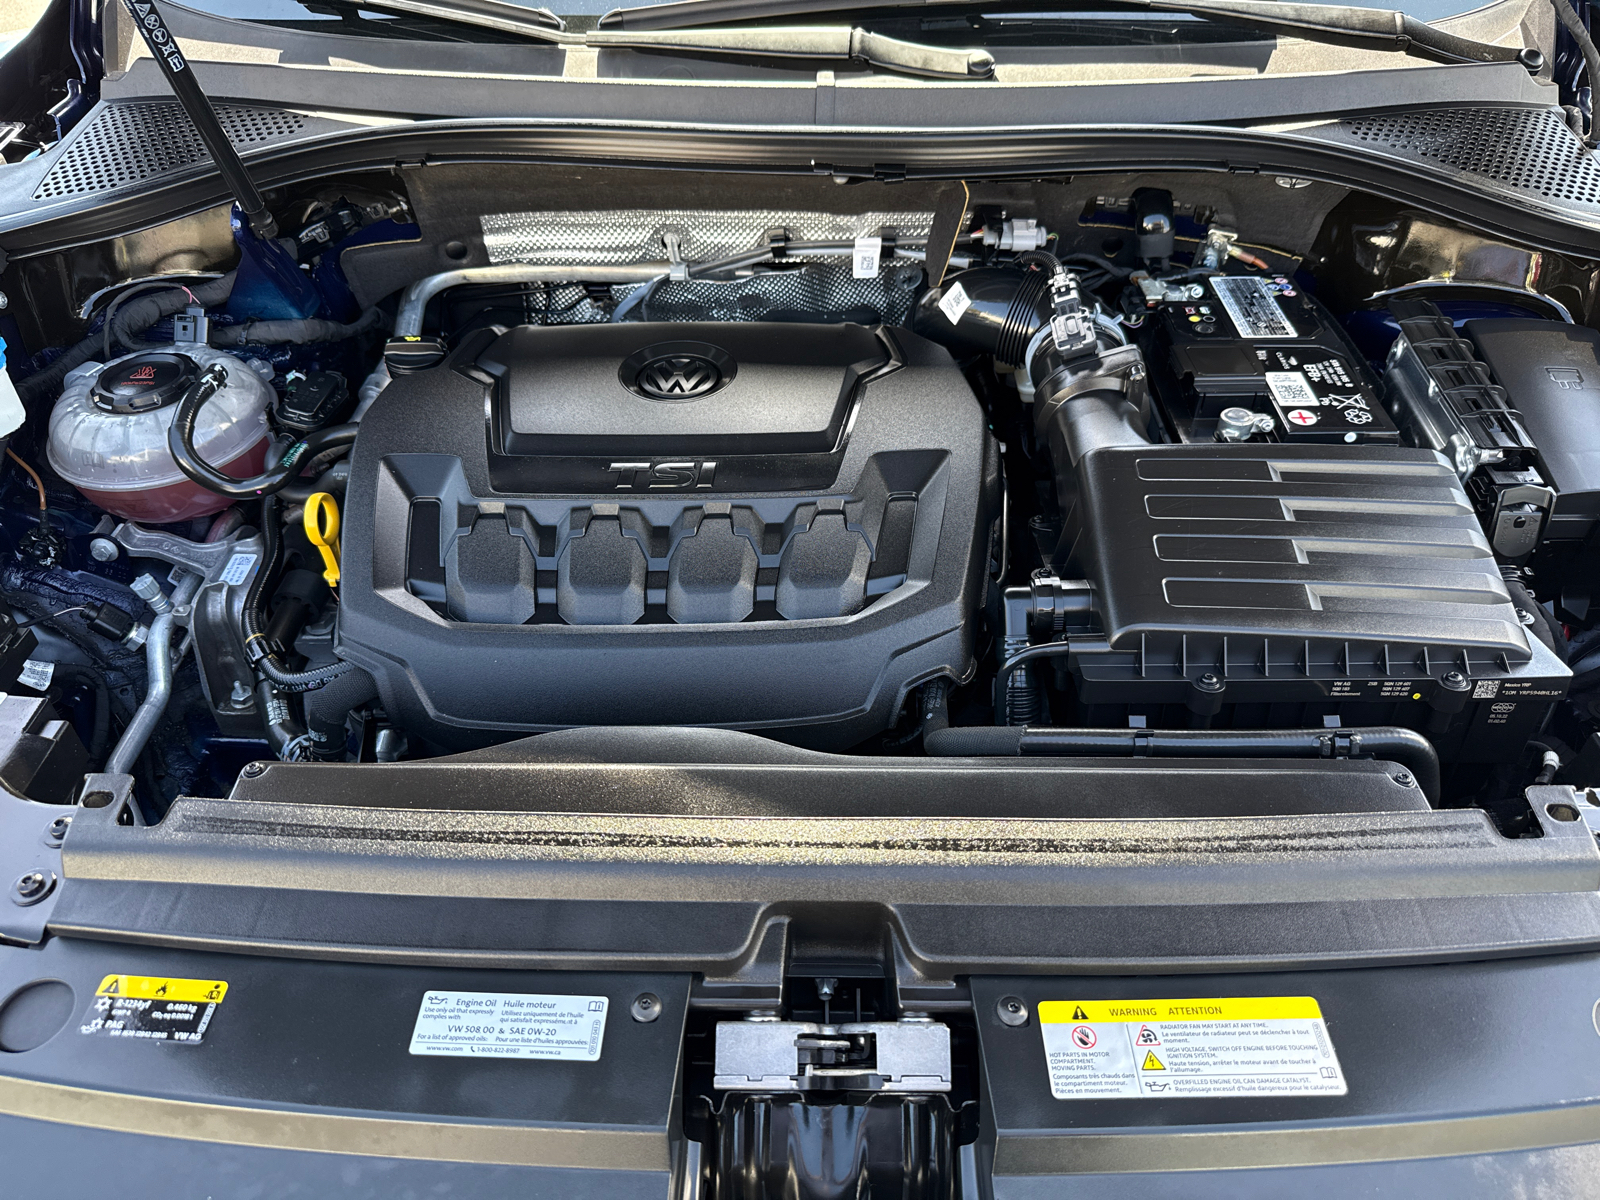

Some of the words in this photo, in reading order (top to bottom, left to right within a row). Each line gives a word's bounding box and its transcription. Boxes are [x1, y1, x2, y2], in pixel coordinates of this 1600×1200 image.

[638, 354, 718, 398] VW
[1303, 364, 1321, 382] EFB+
[608, 462, 717, 489] TSI
[116, 999, 152, 1011] R-1234yf
[456, 998, 483, 1008] Engine
[485, 999, 497, 1007] Oil
[504, 1000, 524, 1008] Huile
[1109, 1008, 1157, 1016] WARNING
[1169, 1006, 1222, 1015] ATTENTION
[105, 1020, 124, 1028] PAG
[174, 1032, 188, 1040] VW
[528, 1028, 556, 1036] 0W-20
[1060, 1080, 1103, 1088] compartiment
